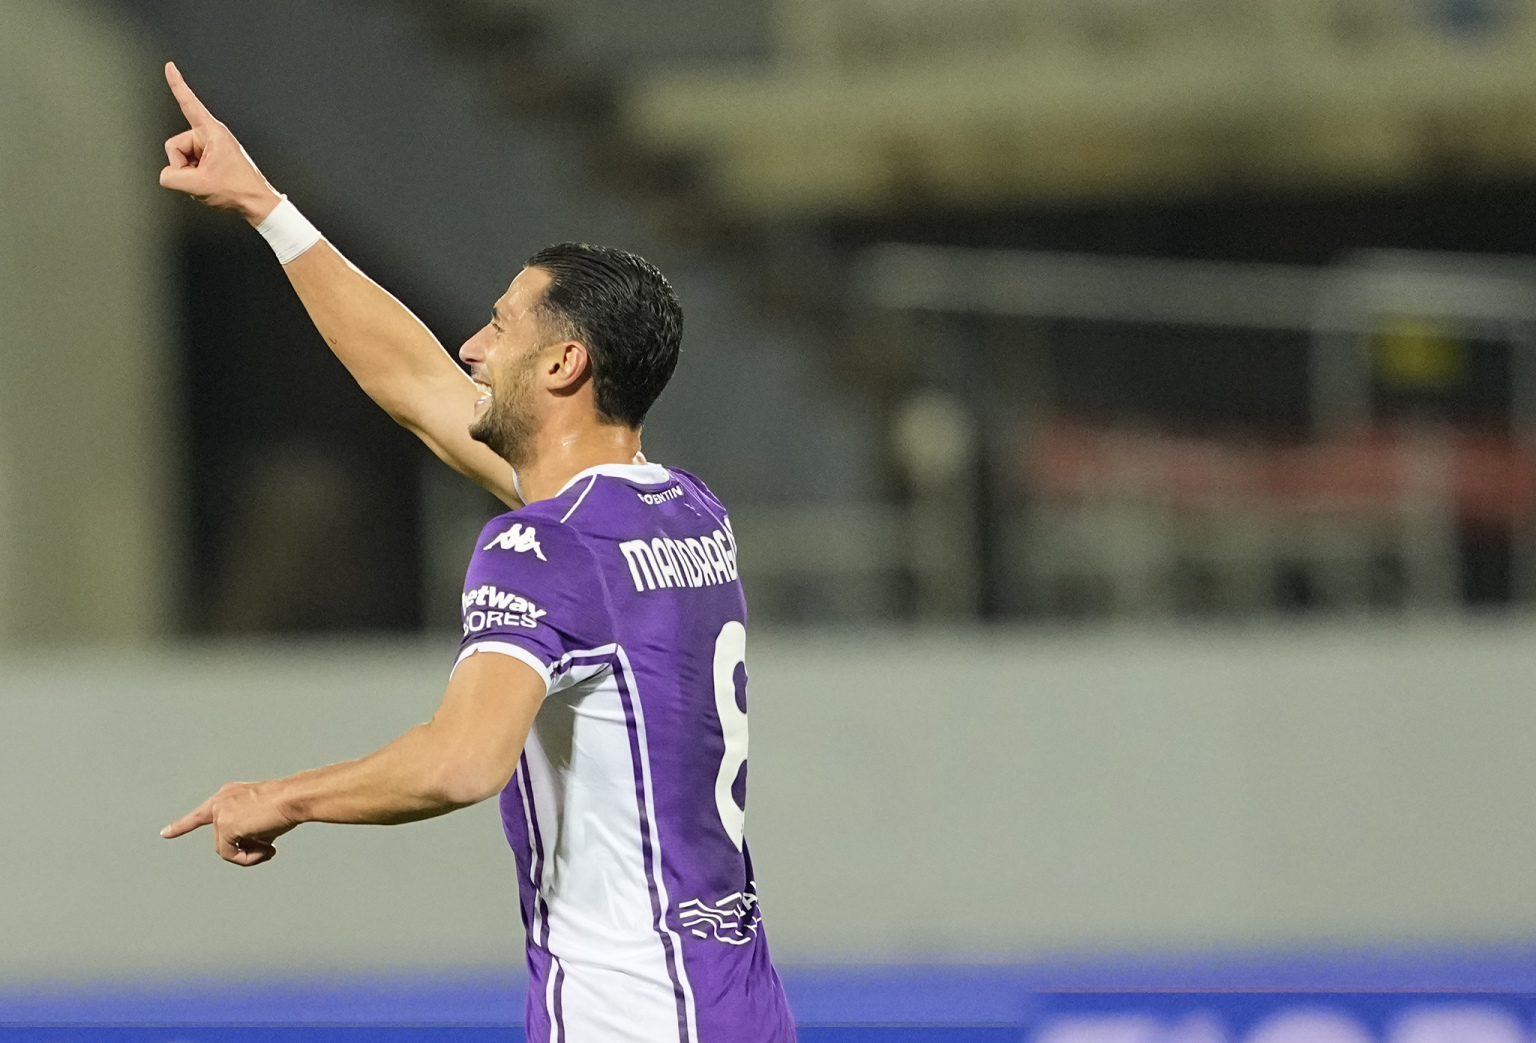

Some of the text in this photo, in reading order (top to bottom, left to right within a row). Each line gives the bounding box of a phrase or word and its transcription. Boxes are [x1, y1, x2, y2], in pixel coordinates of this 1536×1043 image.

[618, 517, 738, 592] MANDRAG
[463, 610, 538, 637] ORES
[713, 620, 749, 853] 8
